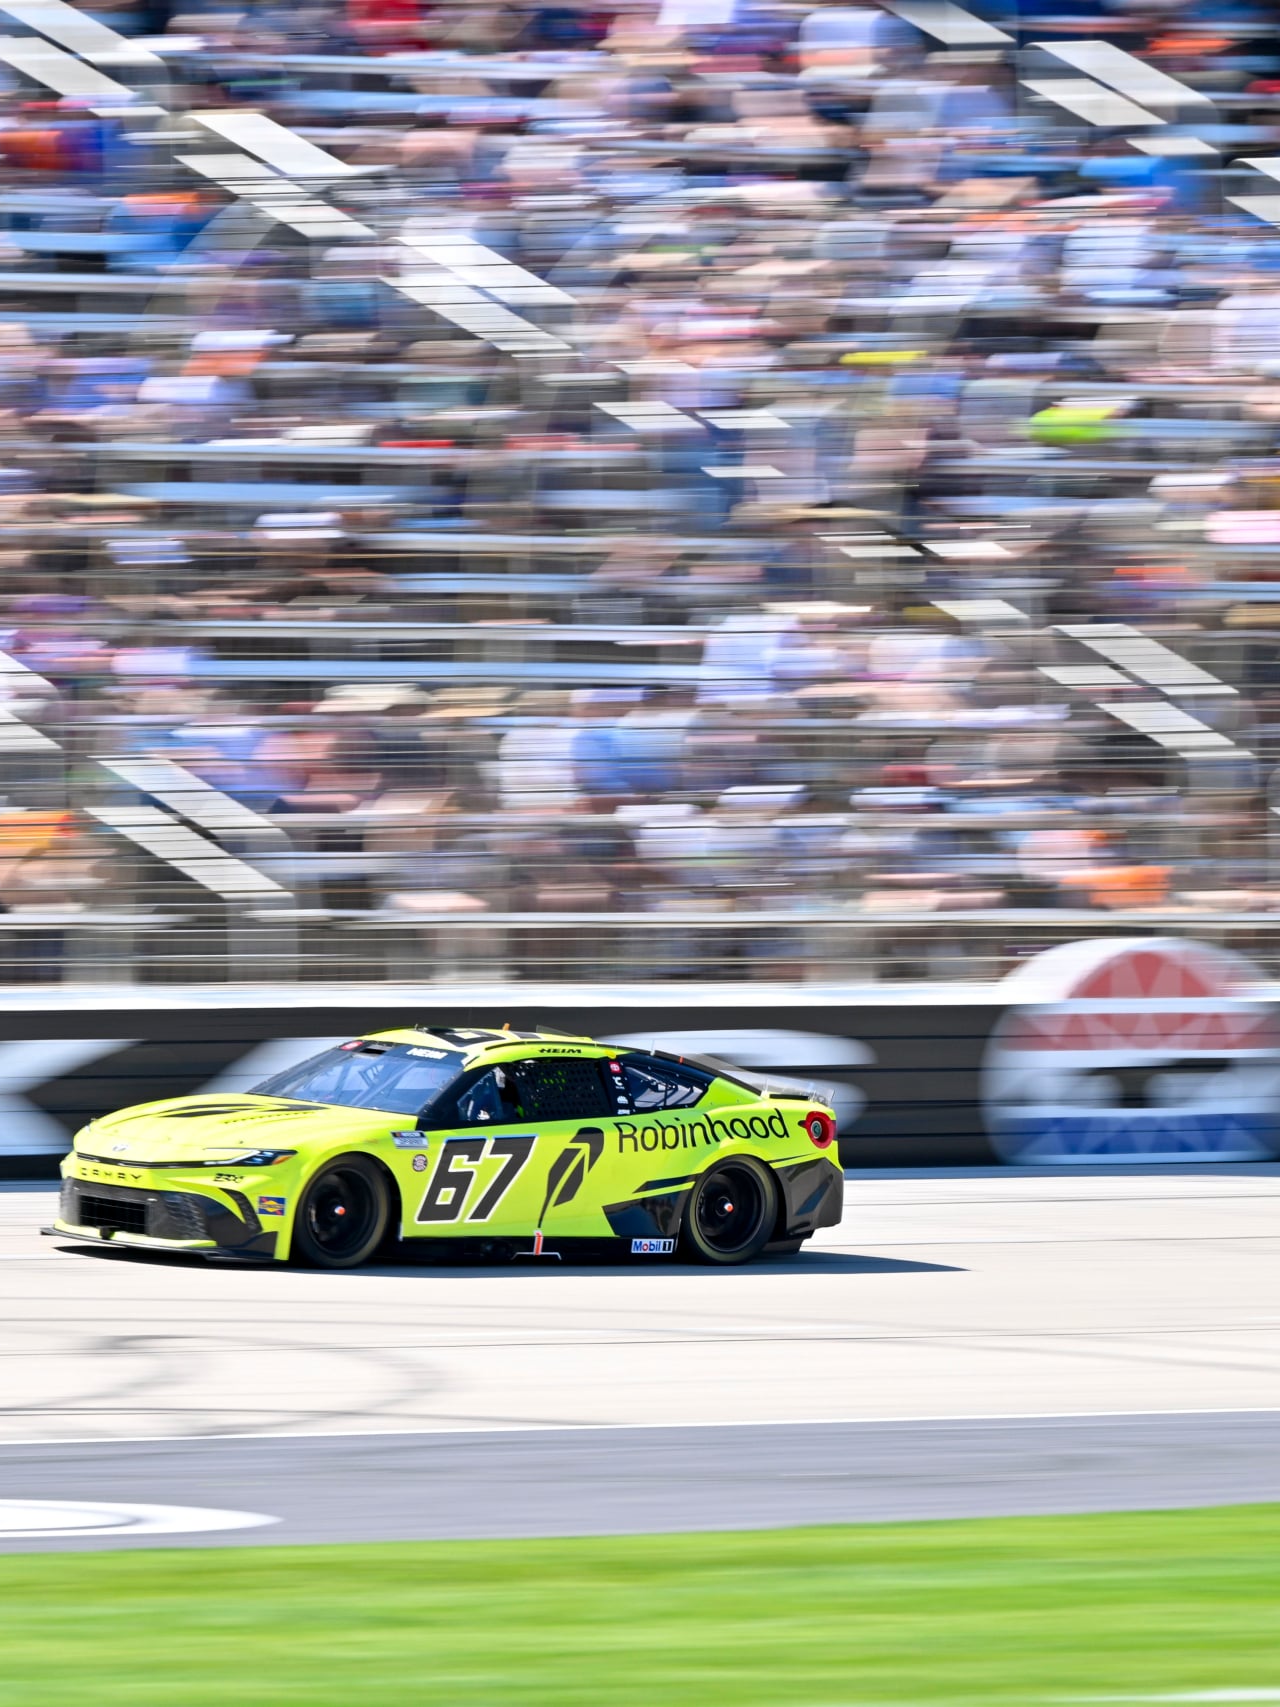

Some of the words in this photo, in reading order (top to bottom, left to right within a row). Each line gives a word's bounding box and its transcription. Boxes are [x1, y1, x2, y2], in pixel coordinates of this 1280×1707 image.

[613, 1108, 790, 1154] Robinhood
[415, 1134, 539, 1225] 67
[633, 1240, 662, 1252] Mobil
